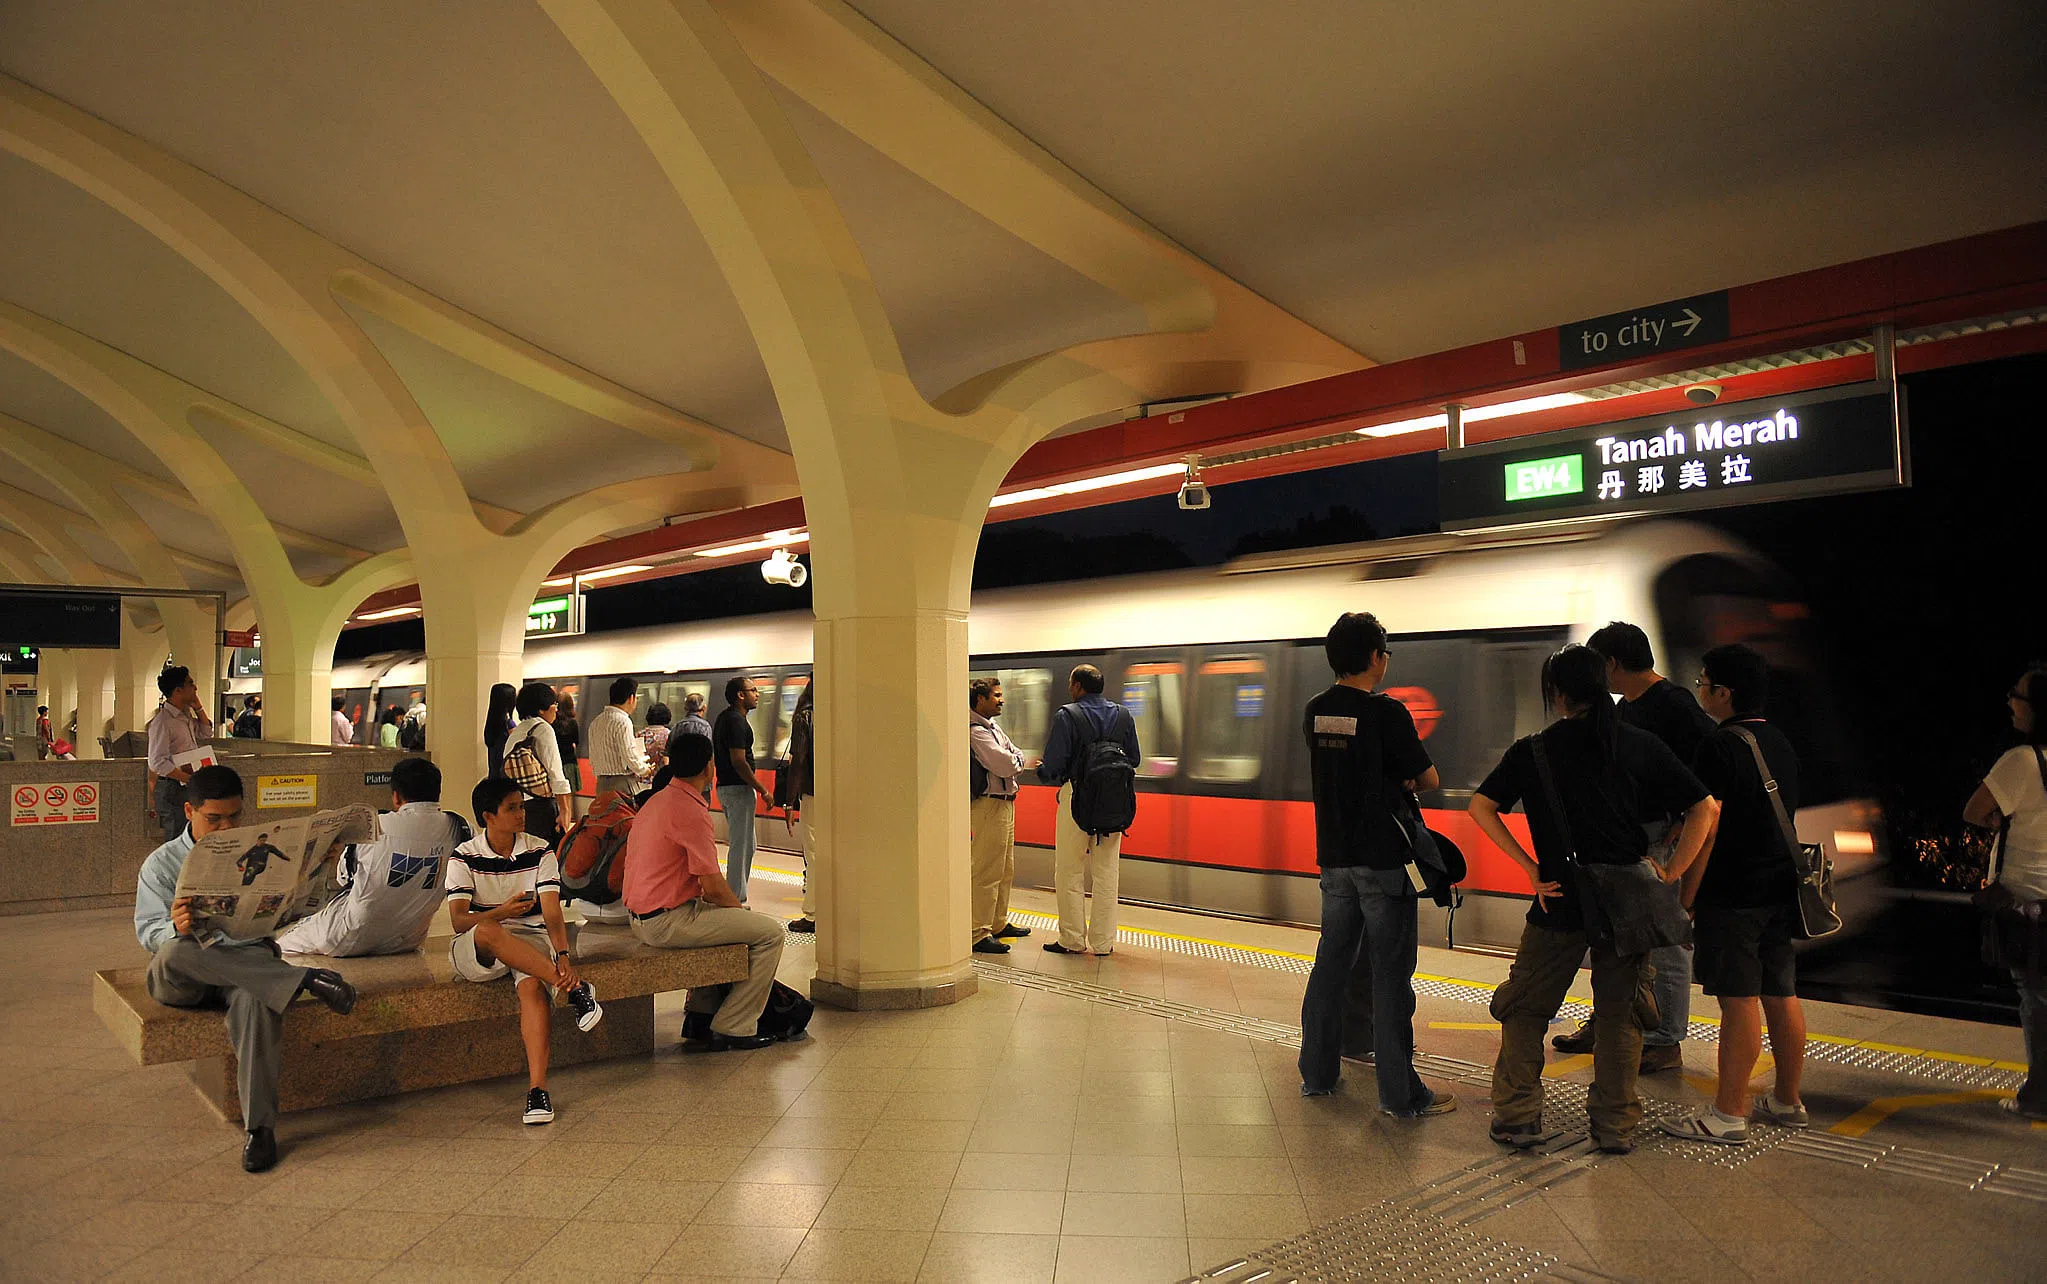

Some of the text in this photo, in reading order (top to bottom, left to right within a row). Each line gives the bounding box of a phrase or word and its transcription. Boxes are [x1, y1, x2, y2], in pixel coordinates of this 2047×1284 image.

[1581, 317, 1665, 354] to city
[1595, 408, 1799, 465] Tanah Merah
[1517, 462, 1571, 493] EW4
[1597, 454, 1753, 500] 丹那美拉
